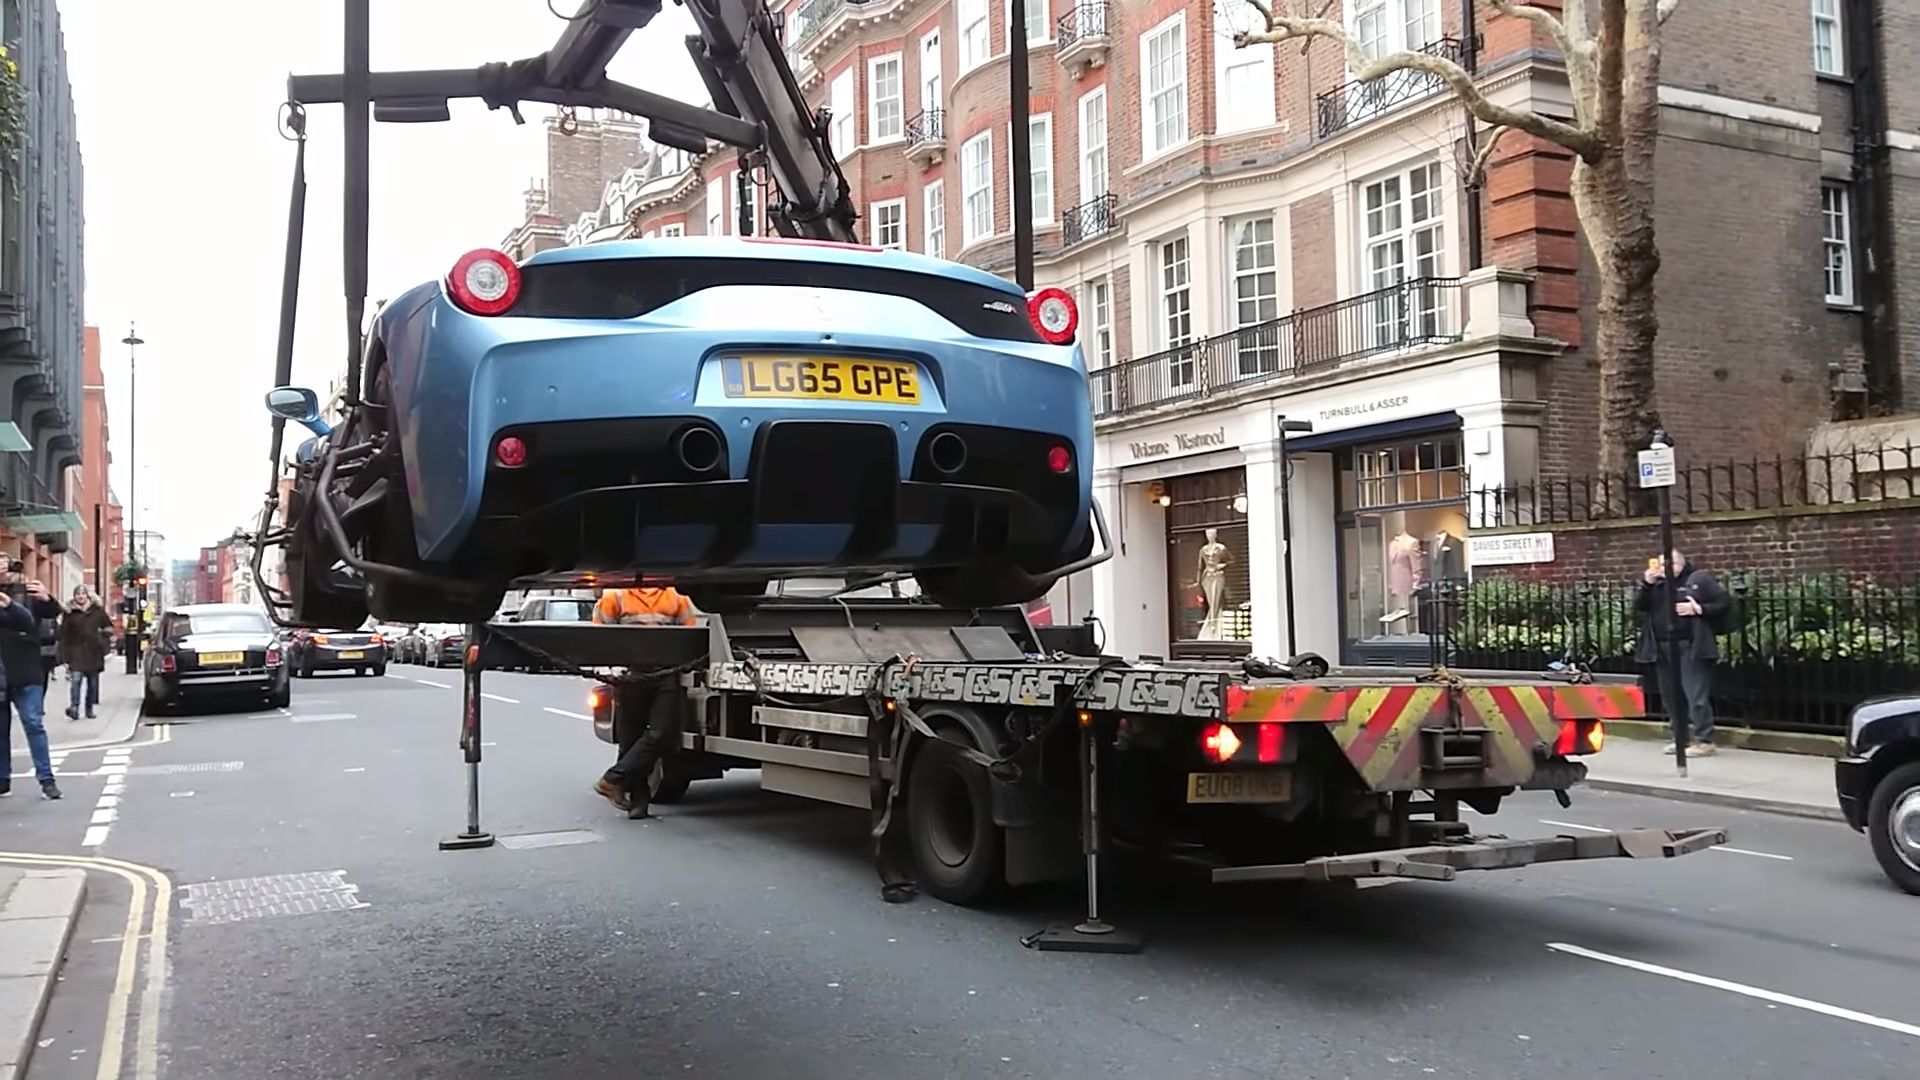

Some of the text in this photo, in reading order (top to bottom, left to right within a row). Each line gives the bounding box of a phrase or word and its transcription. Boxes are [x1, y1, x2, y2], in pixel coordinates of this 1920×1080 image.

[747, 361, 916, 398] LG65 GPE
[1319, 404, 1368, 420] TURNBULL
[1376, 395, 1409, 409] ASSER
[1472, 540, 1501, 551] DAVIES
[1502, 538, 1532, 550] STREET
[1195, 776, 1244, 798] EU08
